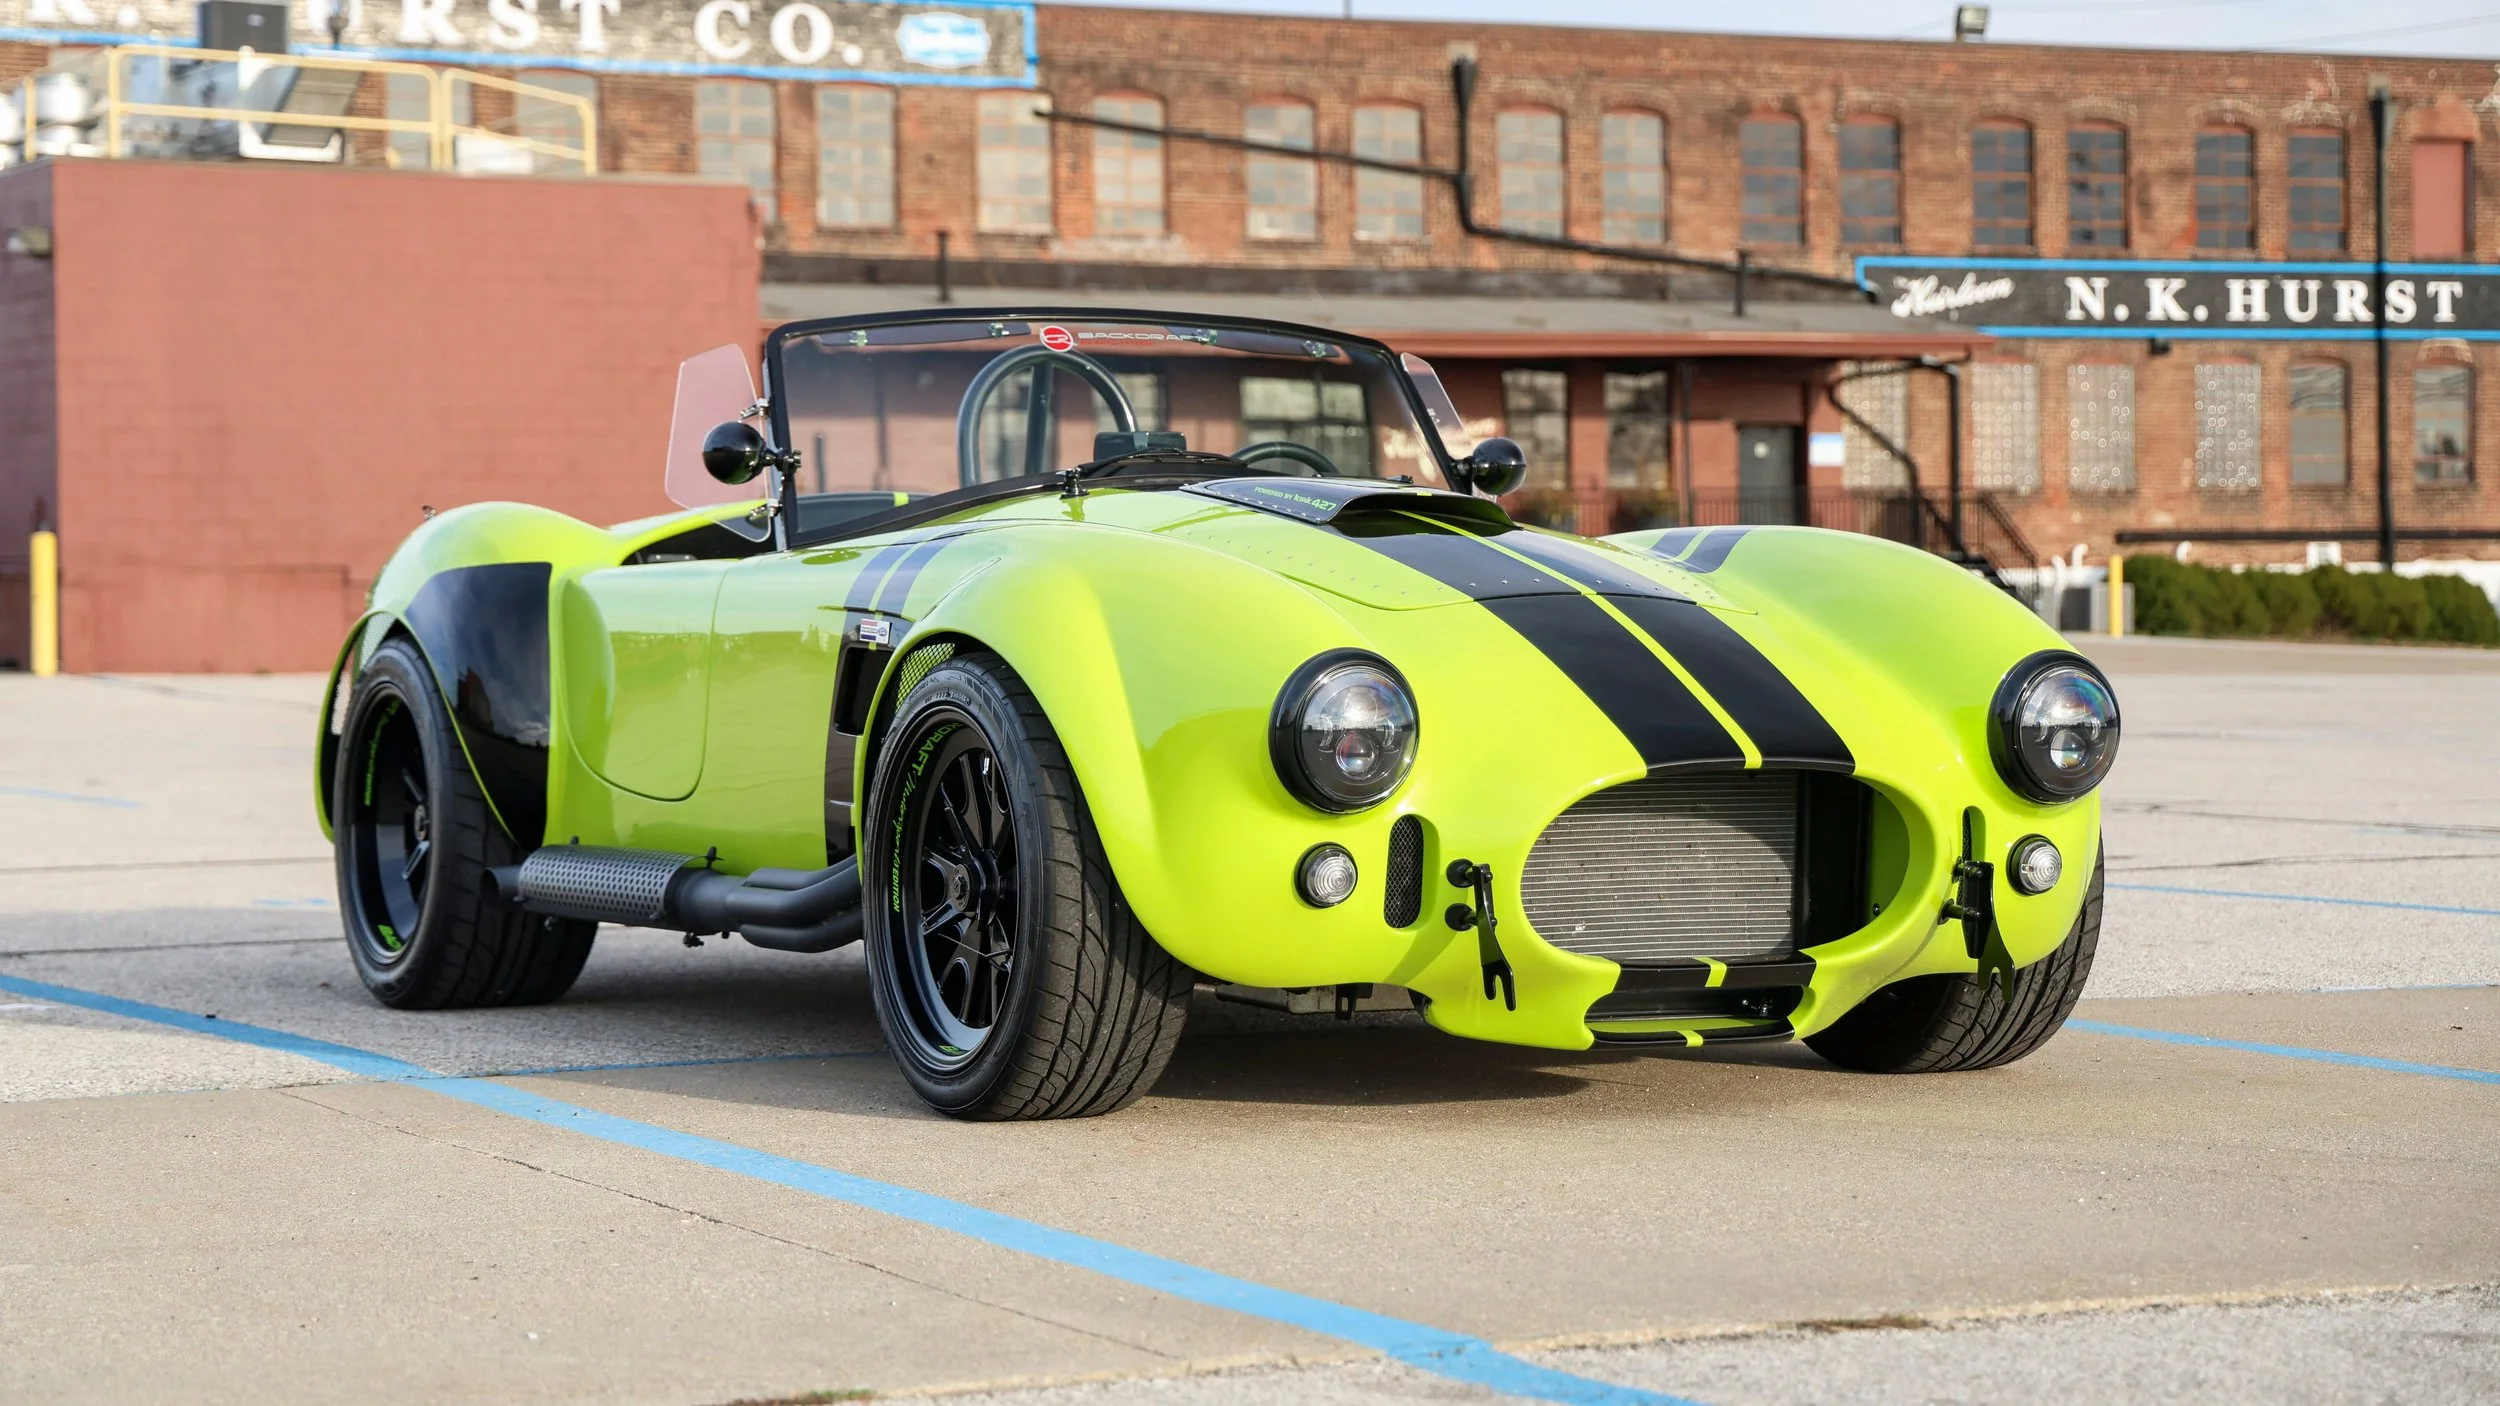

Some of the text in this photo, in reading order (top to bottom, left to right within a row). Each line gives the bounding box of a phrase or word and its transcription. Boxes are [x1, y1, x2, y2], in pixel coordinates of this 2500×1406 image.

[693, 0, 864, 65] CO.
[2224, 278, 2463, 324] HURST
[1255, 487, 1283, 498] POWERED
[1312, 499, 1337, 511] 427
